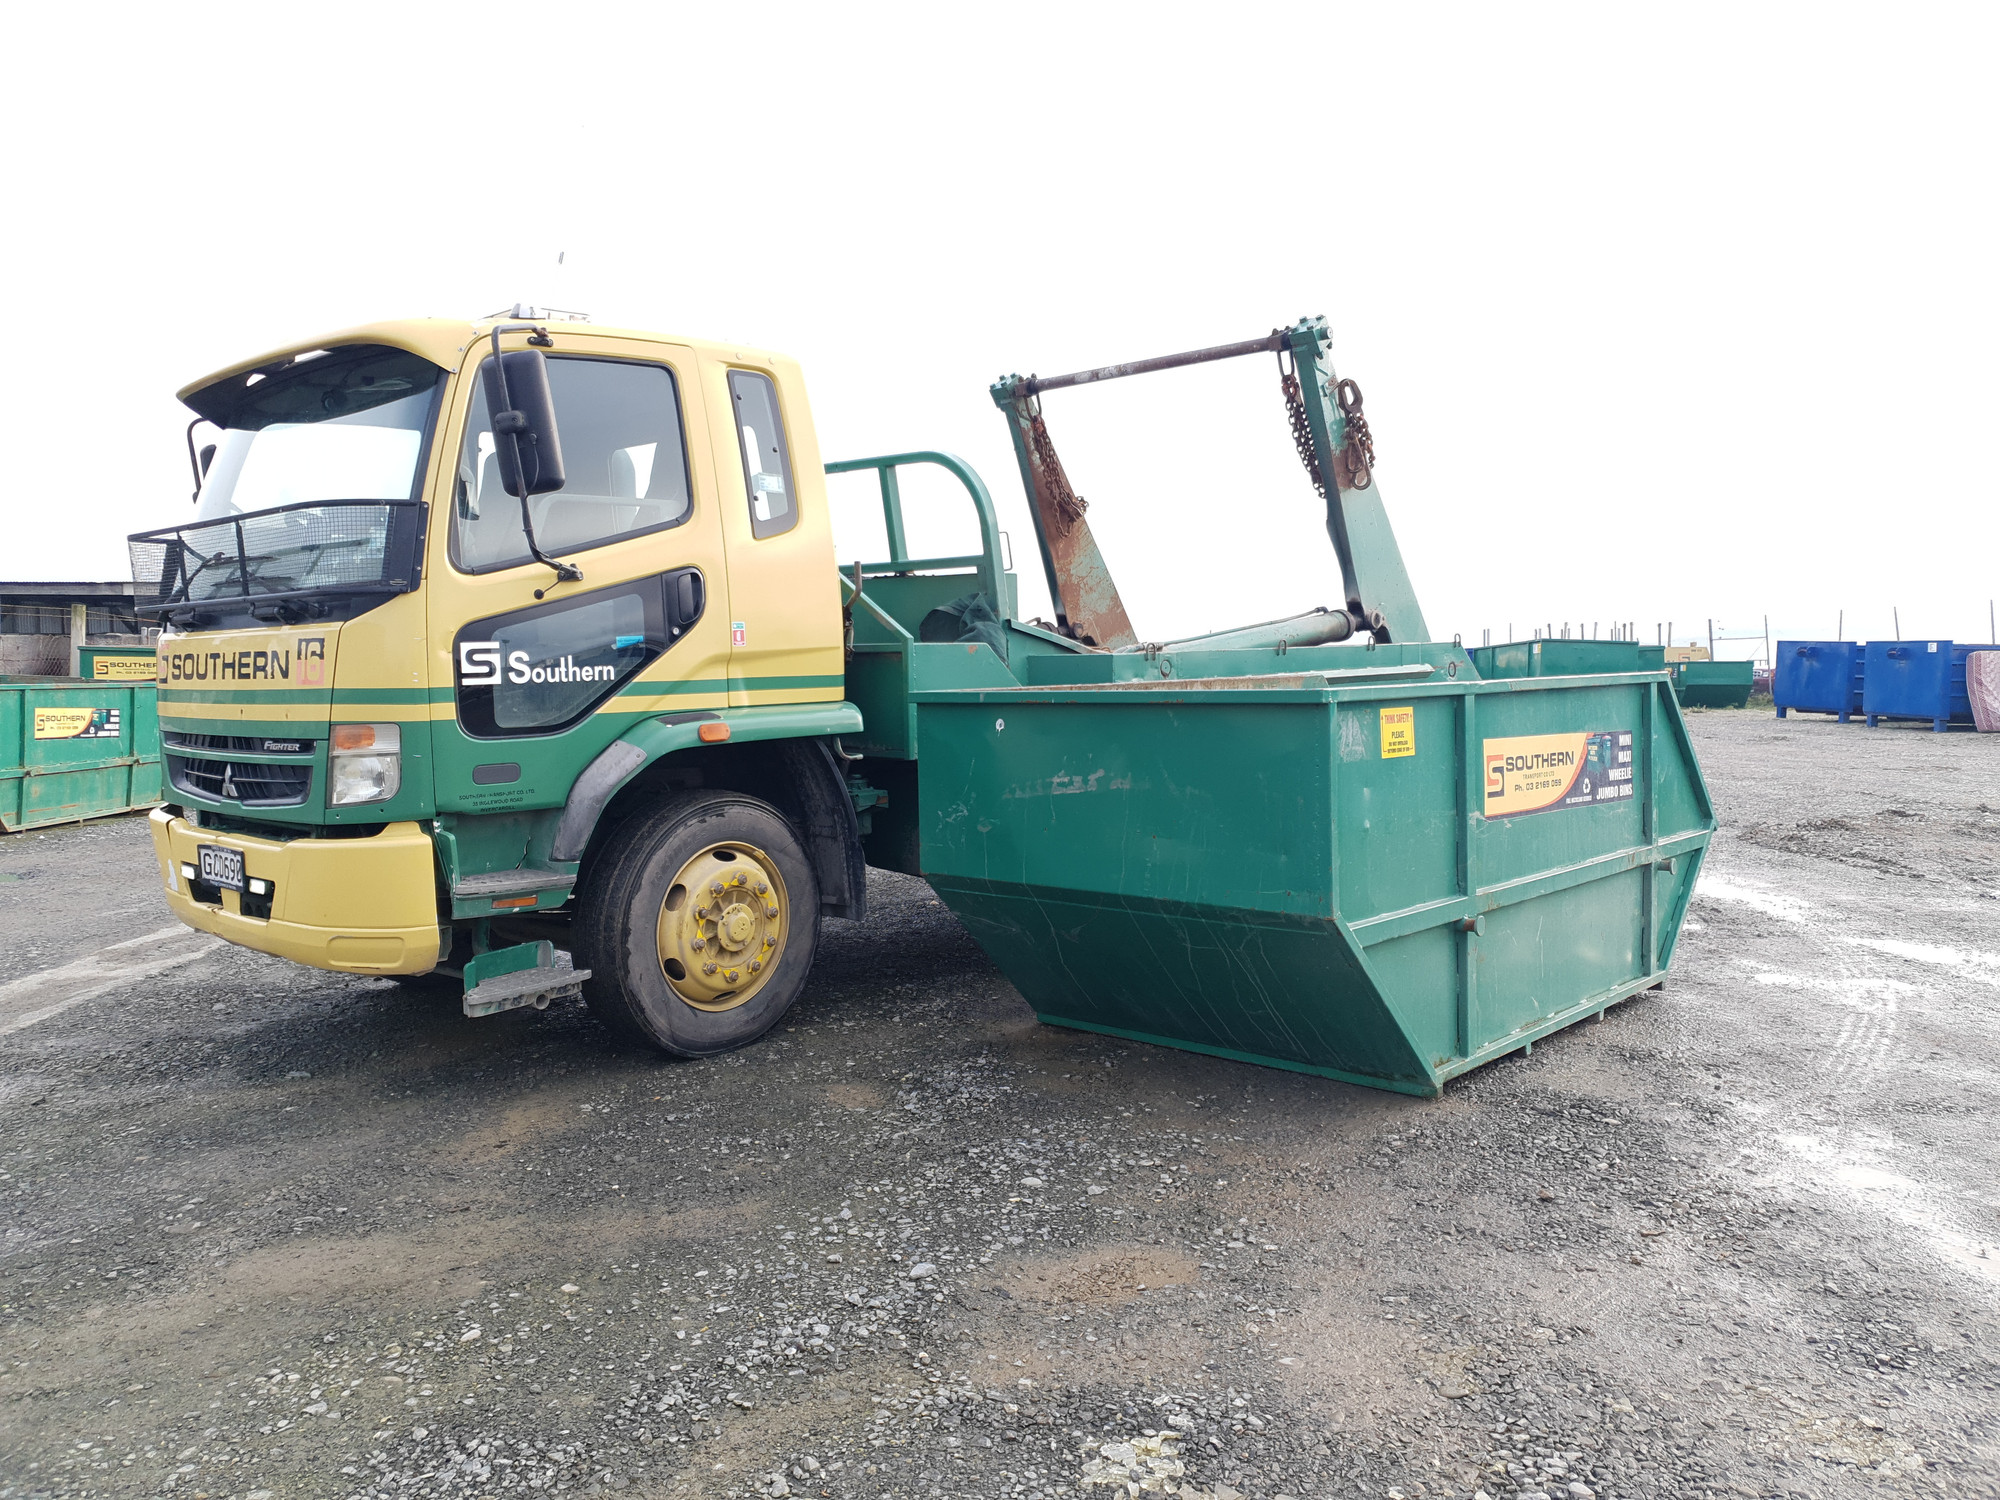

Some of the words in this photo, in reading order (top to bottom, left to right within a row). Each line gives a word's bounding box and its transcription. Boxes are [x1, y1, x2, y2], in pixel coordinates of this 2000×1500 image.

[172, 650, 290, 681] SOUTHERN
[299, 638, 324, 684] 16
[508, 650, 615, 685] Southern
[1505, 750, 1575, 773] SOUTHERN
[1608, 766, 1633, 782] WHEELIE
[1525, 782, 1535, 791] 03
[1535, 780, 1551, 789] 2169
[1596, 784, 1619, 801] JUMBO
[1619, 783, 1633, 797] BINS
